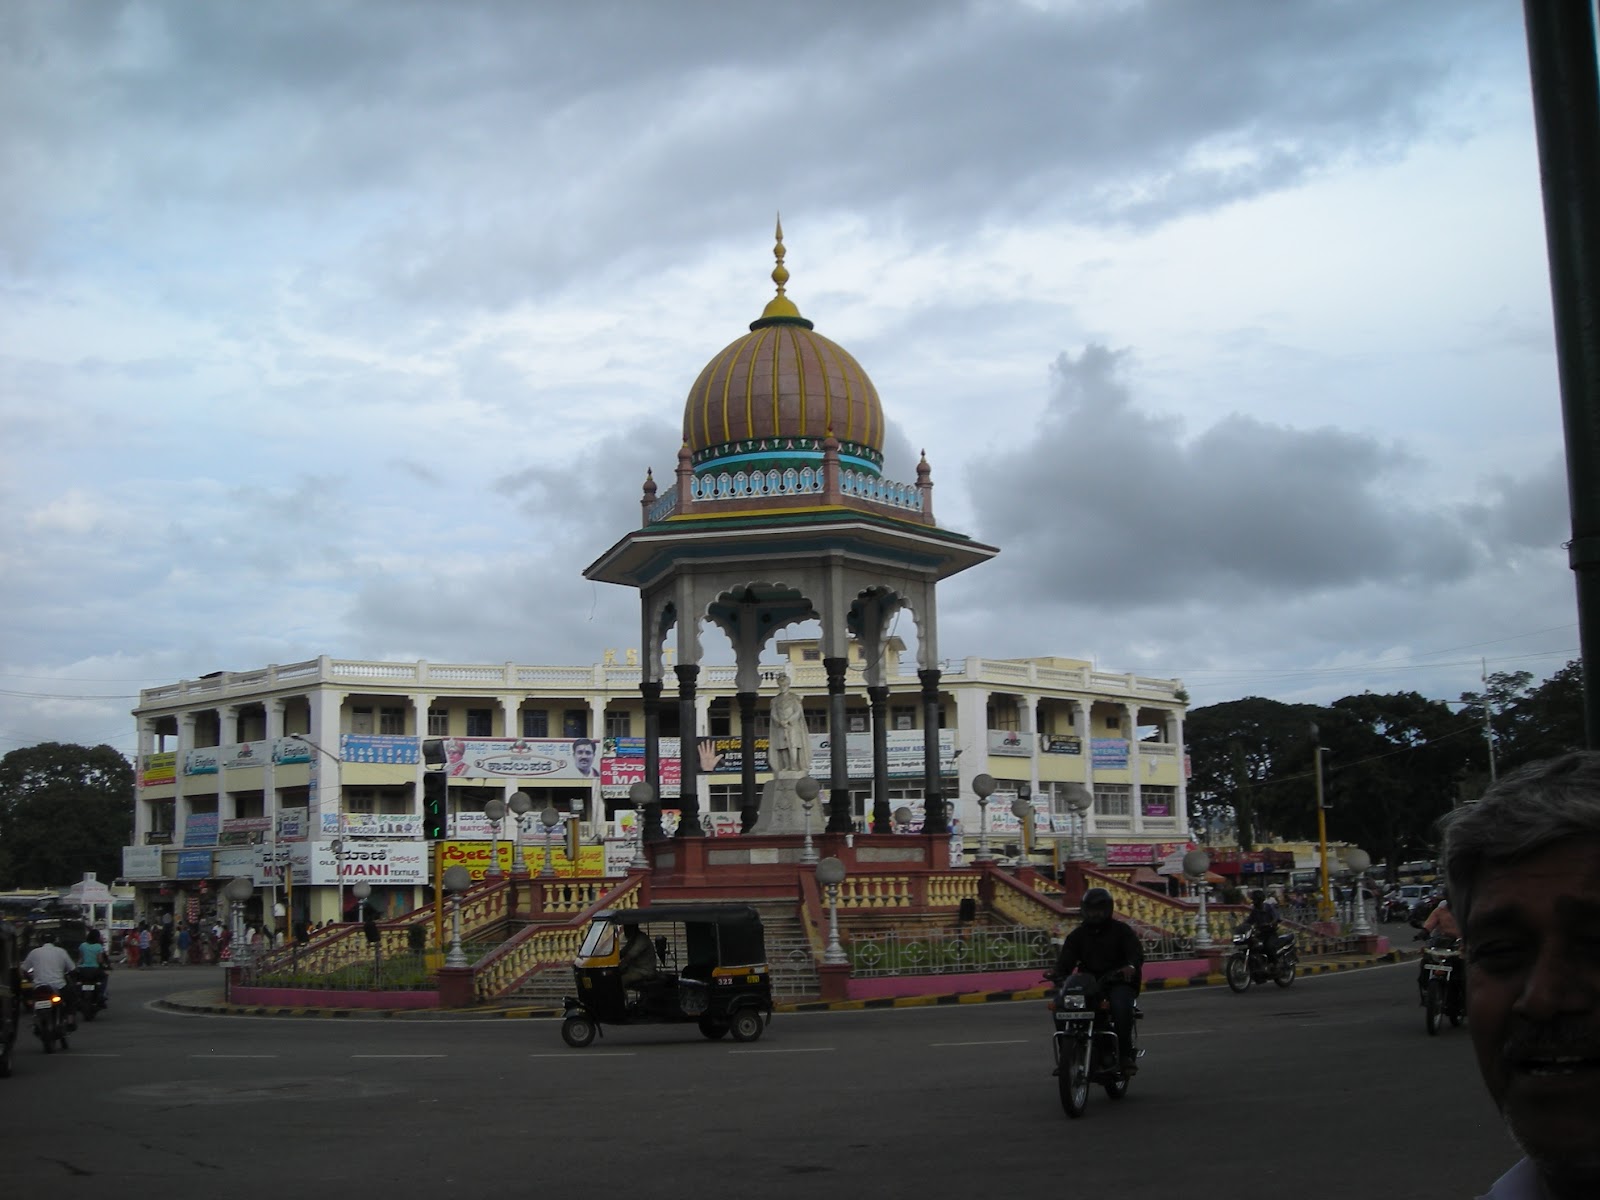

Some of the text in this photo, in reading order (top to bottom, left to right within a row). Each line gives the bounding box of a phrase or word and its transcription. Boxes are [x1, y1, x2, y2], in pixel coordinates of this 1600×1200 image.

[284, 747, 308, 757] English
[612, 775, 664, 785] MAI
[336, 864, 389, 876] MANI
